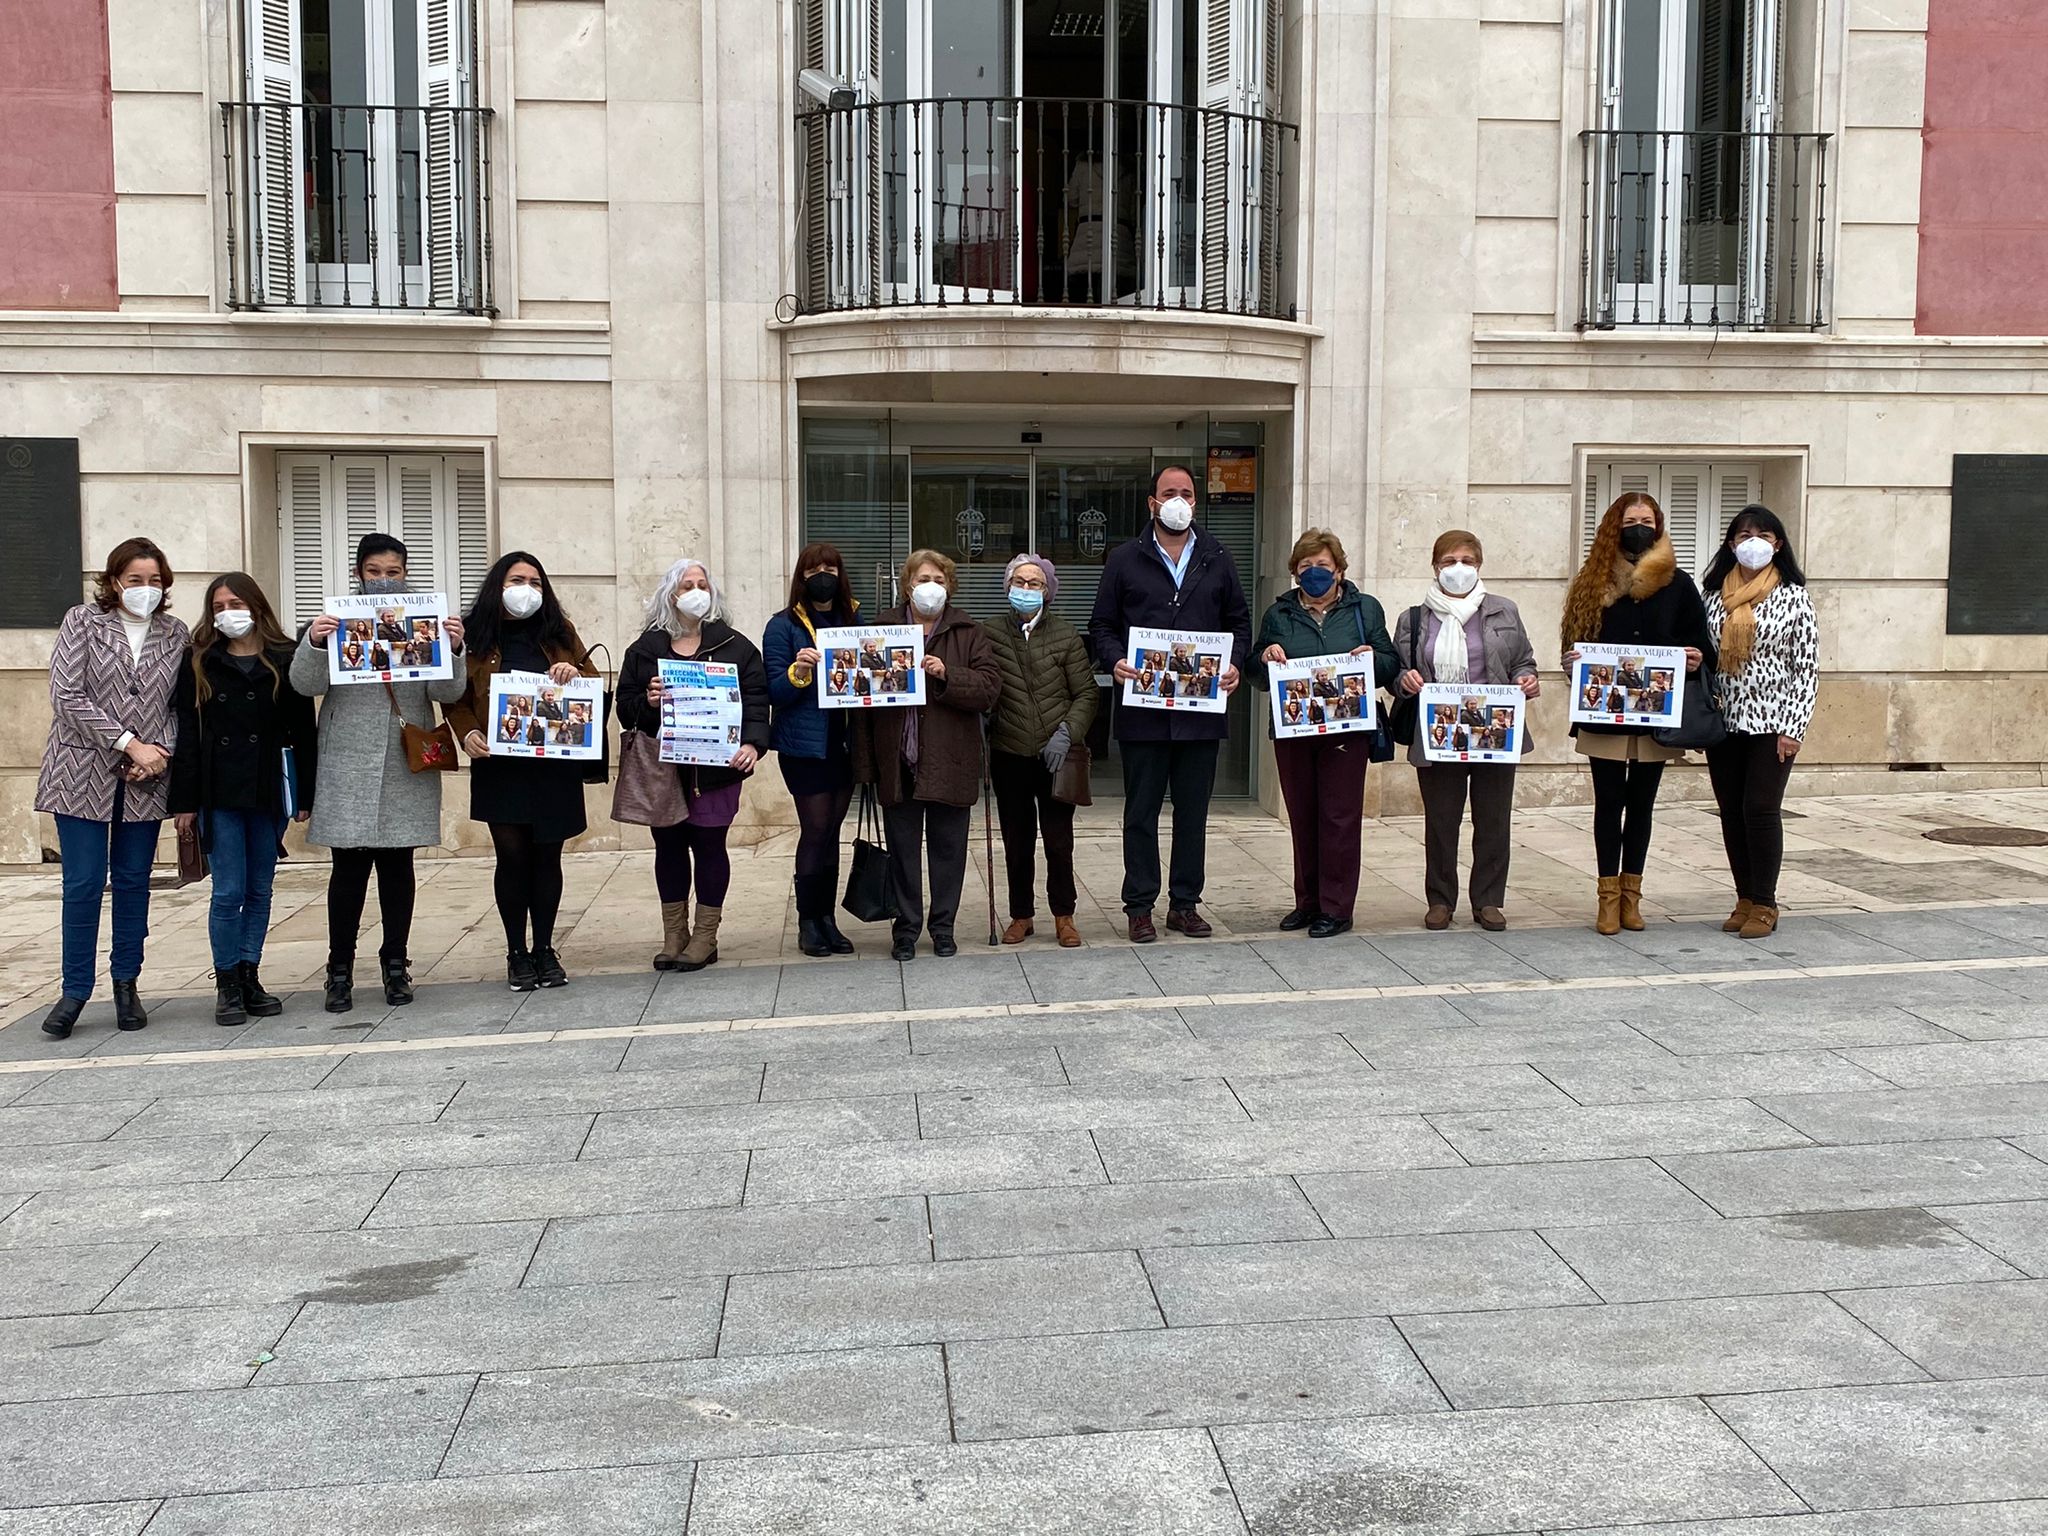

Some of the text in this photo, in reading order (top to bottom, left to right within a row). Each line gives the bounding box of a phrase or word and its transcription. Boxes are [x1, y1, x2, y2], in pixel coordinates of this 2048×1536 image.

[355, 597, 388, 608] MUJER
[391, 597, 400, 605] A
[841, 629, 871, 639] MUJER
[874, 629, 881, 637] A
[1155, 632, 1183, 642] MUJER
[1600, 646, 1631, 656] MUJER
[1293, 659, 1322, 669] MUJER
[519, 676, 550, 686] MUJER
[1444, 686, 1473, 696] MUJER
